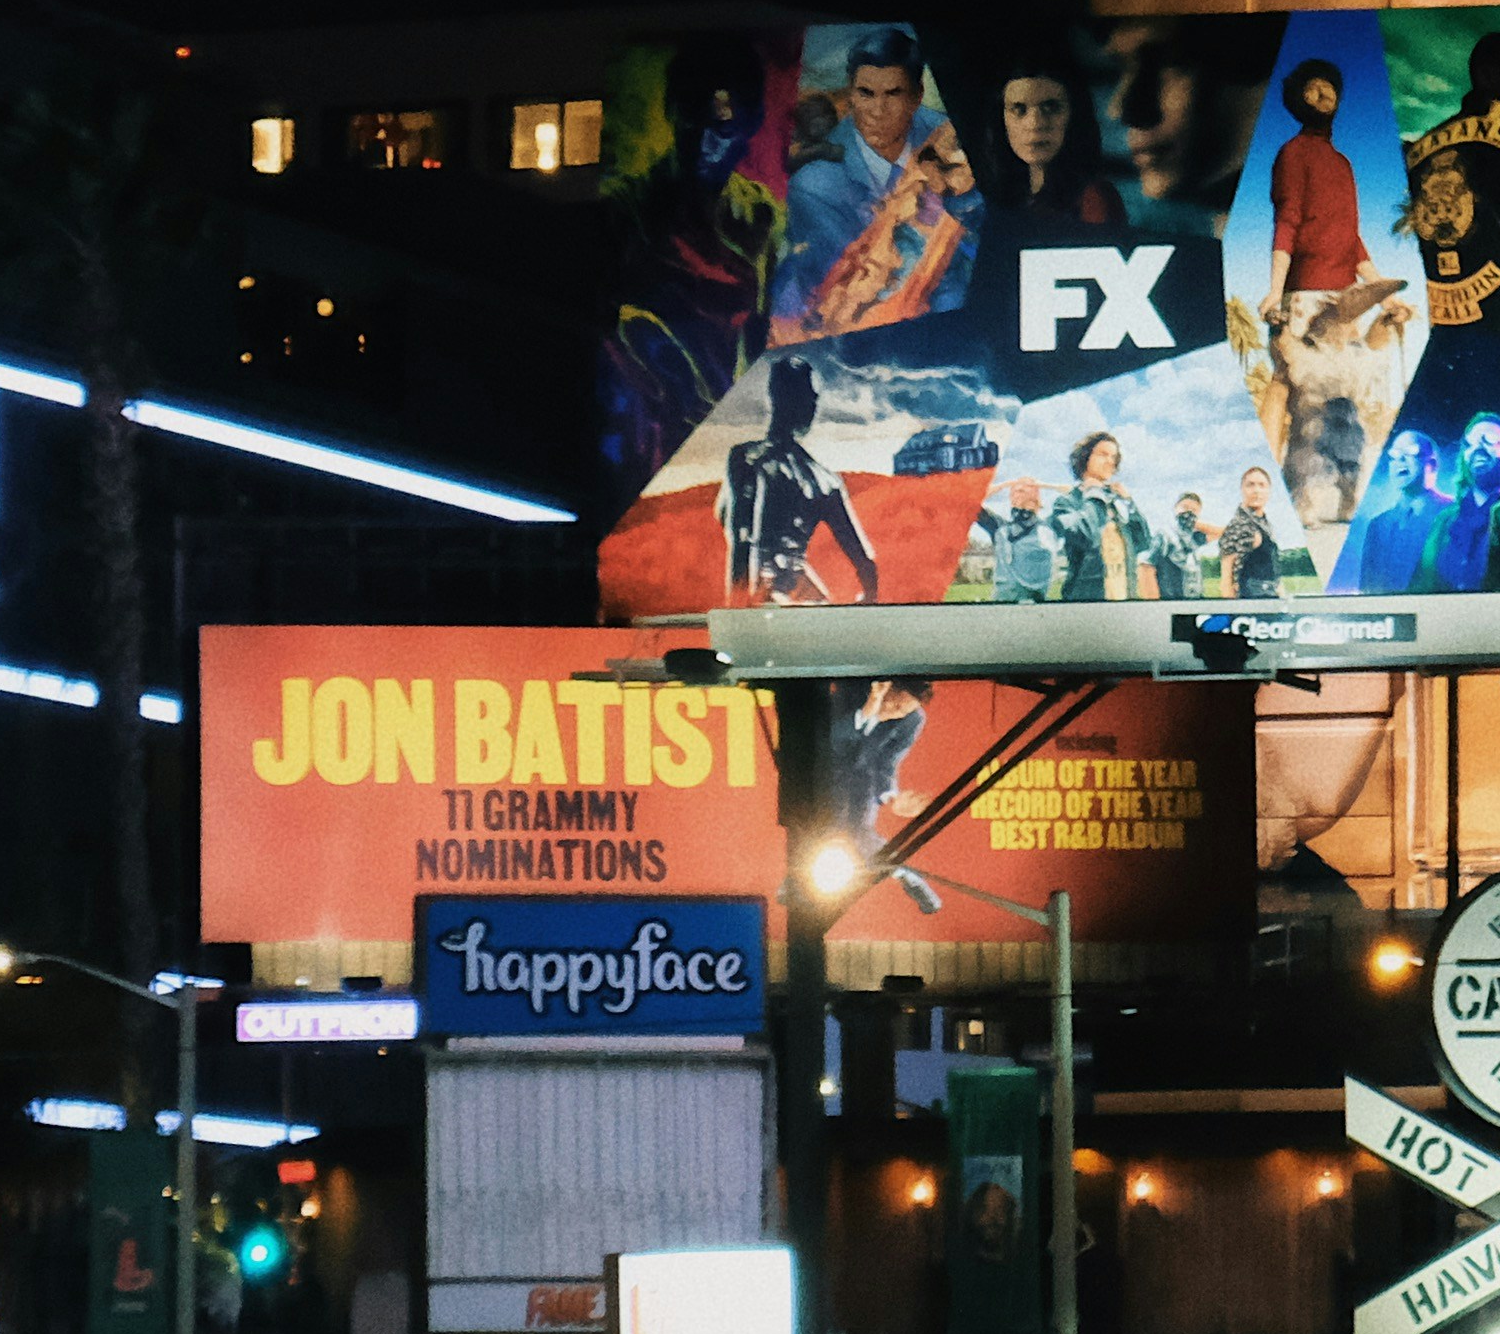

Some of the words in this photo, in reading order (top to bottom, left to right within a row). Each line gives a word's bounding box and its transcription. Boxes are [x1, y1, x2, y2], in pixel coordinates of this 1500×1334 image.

[1019, 244, 1176, 351] FX
[1231, 616, 1293, 639] Clear
[1293, 616, 1395, 641] Channel
[252, 676, 434, 786] JON
[454, 677, 779, 788] BATIST
[1058, 758, 1089, 789] OF
[1091, 758, 1137, 789] THE
[1140, 759, 1198, 789] YEAR
[441, 788, 474, 831] 11
[482, 789, 639, 832] GRAMMY
[970, 789, 1062, 819] RECORD
[1065, 789, 1094, 819] OF
[1096, 789, 1145, 819] THE
[1148, 790, 1204, 819] YEAR
[990, 820, 1051, 850] BEST
[1054, 820, 1103, 850] R&B
[1106, 821, 1185, 850] ALBUM
[415, 838, 667, 883] NOMINATIONS
[440, 920, 748, 1014] happyface
[1382, 1115, 1488, 1194] HOT
